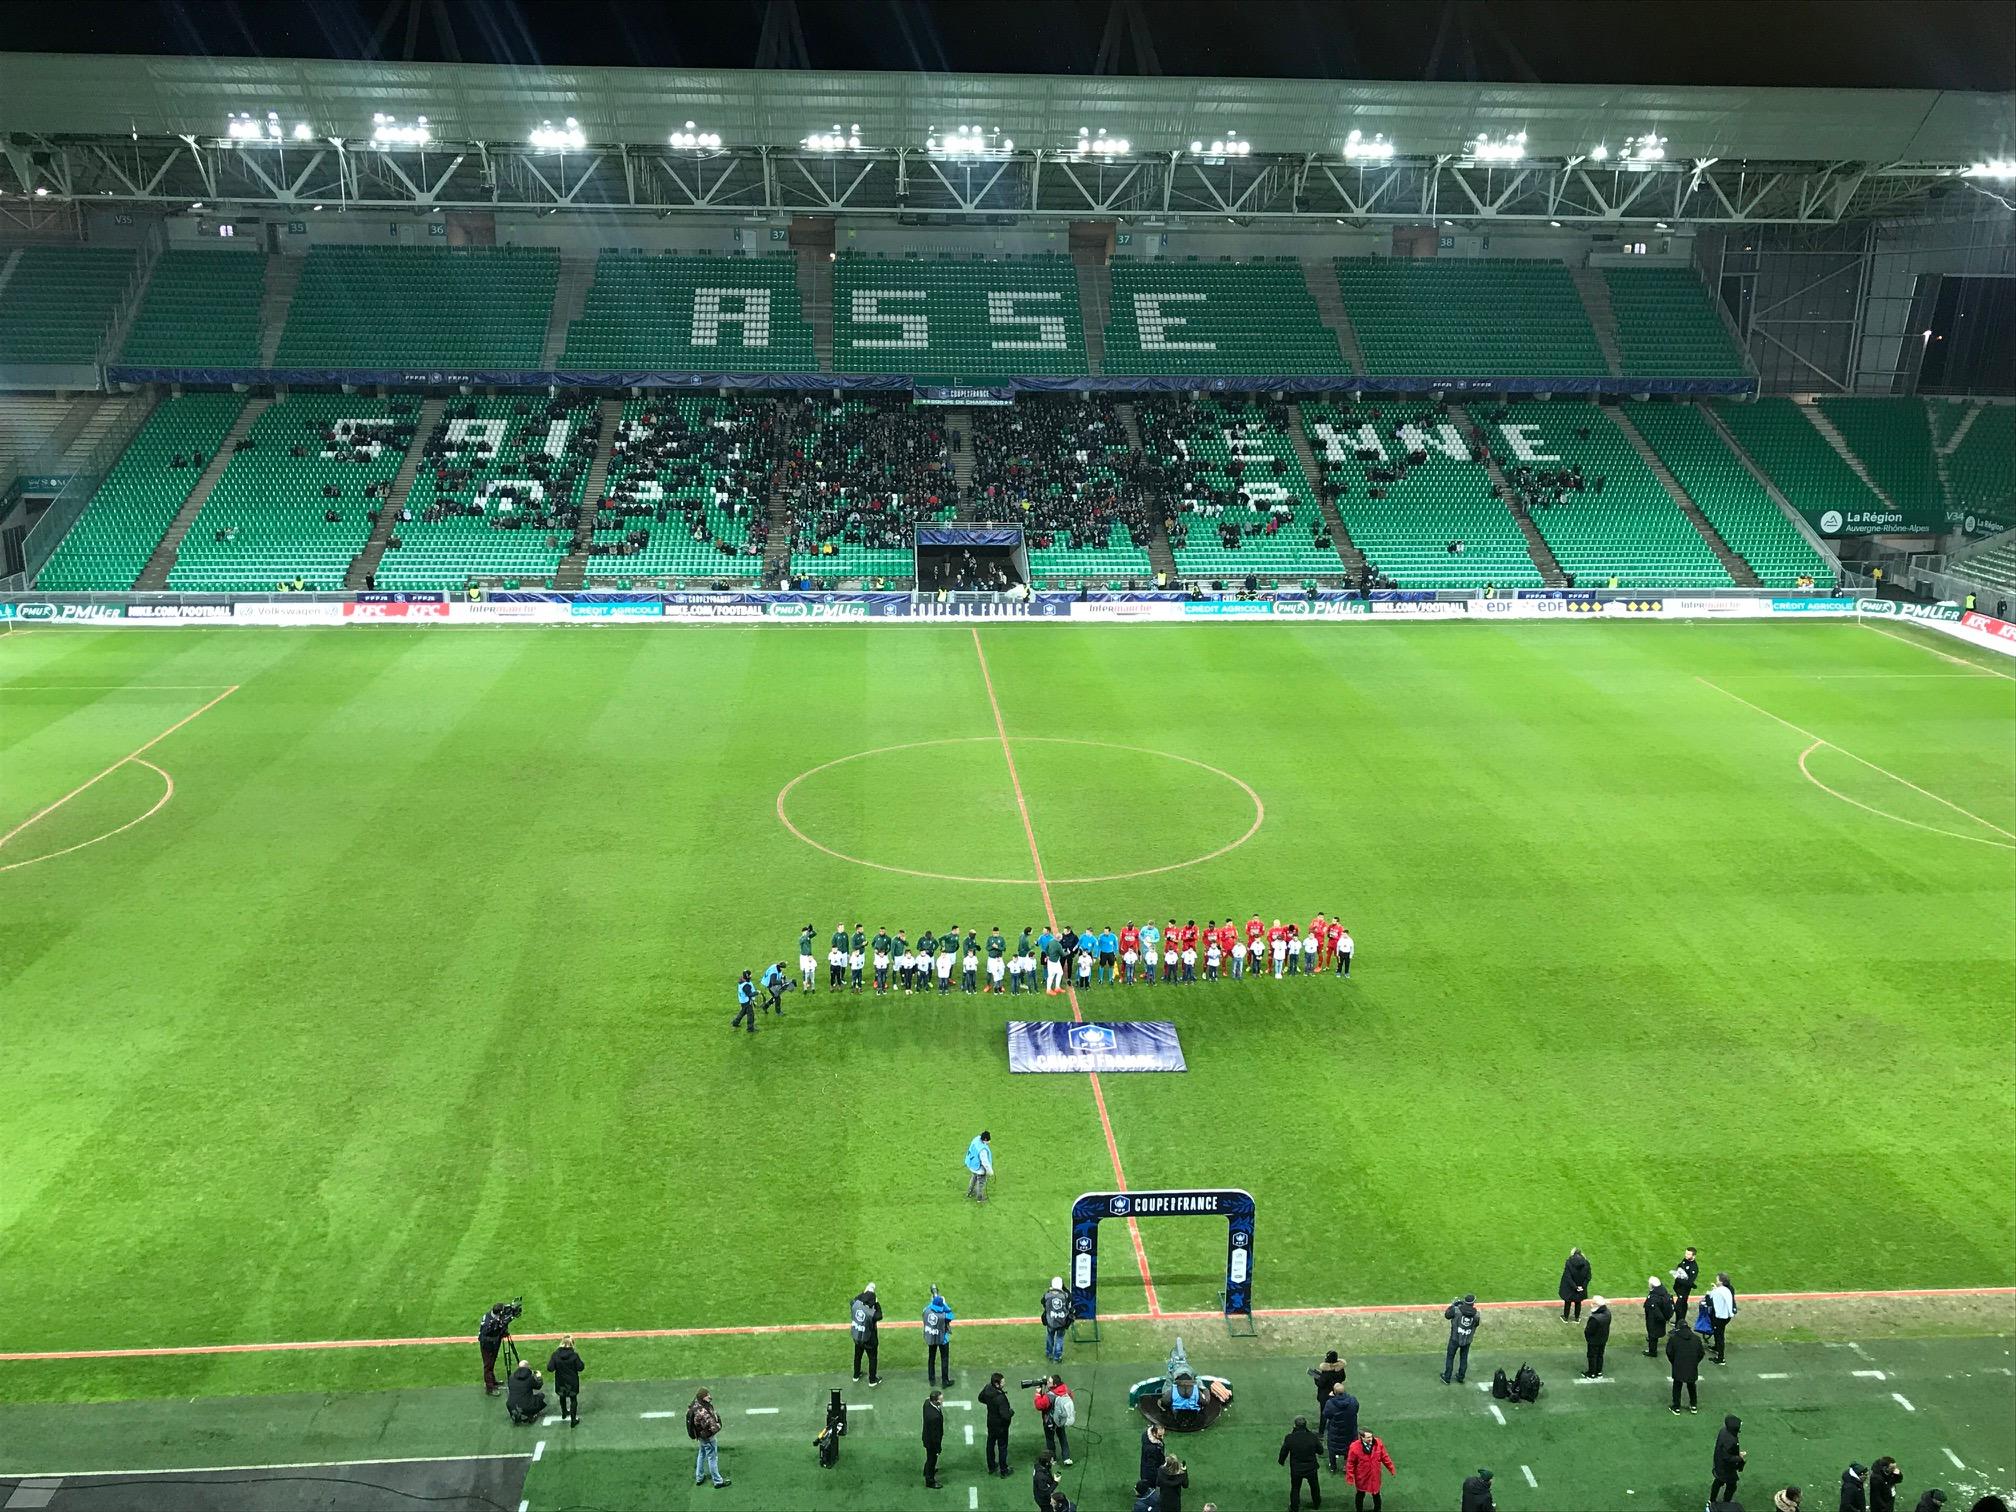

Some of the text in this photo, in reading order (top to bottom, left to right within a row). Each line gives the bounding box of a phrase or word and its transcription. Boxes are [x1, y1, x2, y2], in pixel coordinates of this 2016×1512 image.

[772, 230, 785, 239] 37
[1118, 235, 1130, 244] 37
[1440, 238, 1453, 247] 38
[691, 287, 1216, 350] ASSE
[1847, 511, 1903, 524] La Région
[1846, 524, 1930, 533] Auvergne-Rhône-Alpes
[353, 604, 386, 616] KFC
[407, 604, 441, 616] KFC
[609, 606, 660, 615] AGRICOLE
[910, 603, 1030, 616] COUPE DE FRANCE
[1221, 604, 1269, 613] AGRICOLE
[1807, 602, 1853, 610] AGRICOLE
[258, 607, 321, 617] Volkswagen
[1966, 614, 1991, 631] KFC
[1134, 1197, 1169, 1212] COUPE
[1177, 1196, 1218, 1211] FRANCE
